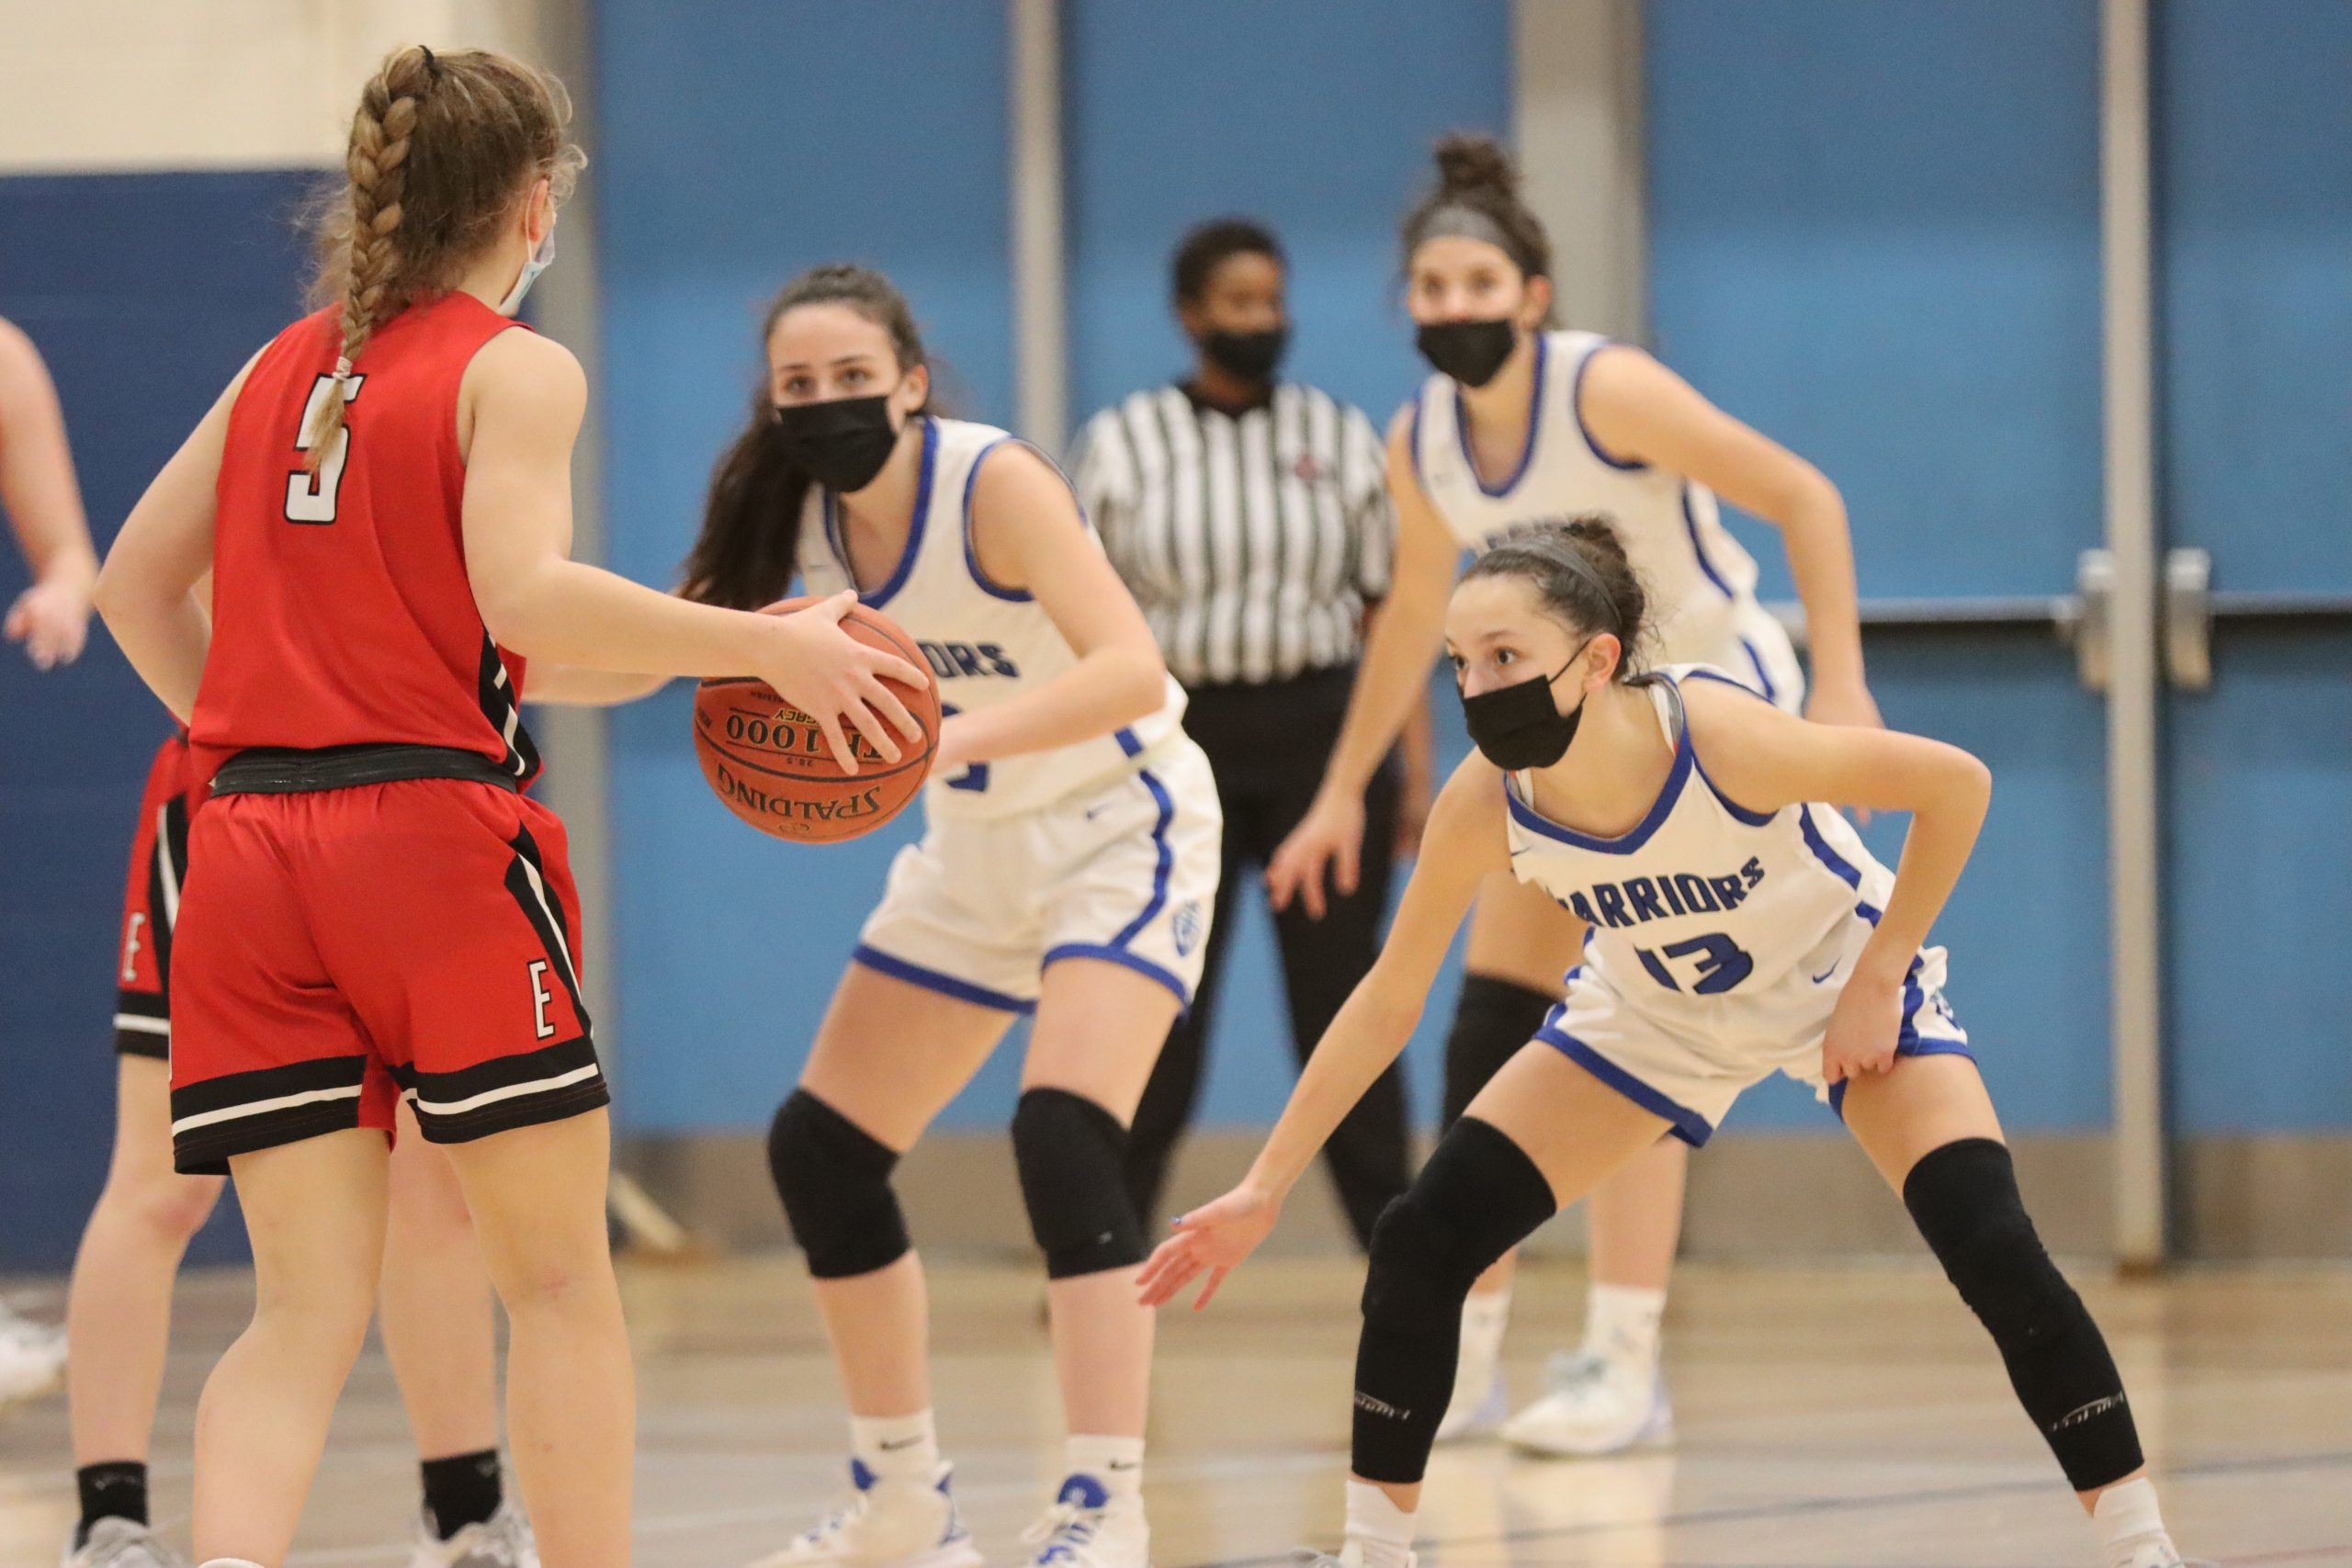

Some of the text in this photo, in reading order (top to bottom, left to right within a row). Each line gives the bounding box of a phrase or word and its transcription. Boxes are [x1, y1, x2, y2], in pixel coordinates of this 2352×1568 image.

[284, 372, 368, 525] 5
[775, 708, 820, 725] GACY
[717, 762, 882, 820] SPALDING
[1546, 855, 1765, 928] ARRIORS
[1633, 931, 1754, 995] 13
[526, 957, 556, 1042] E
